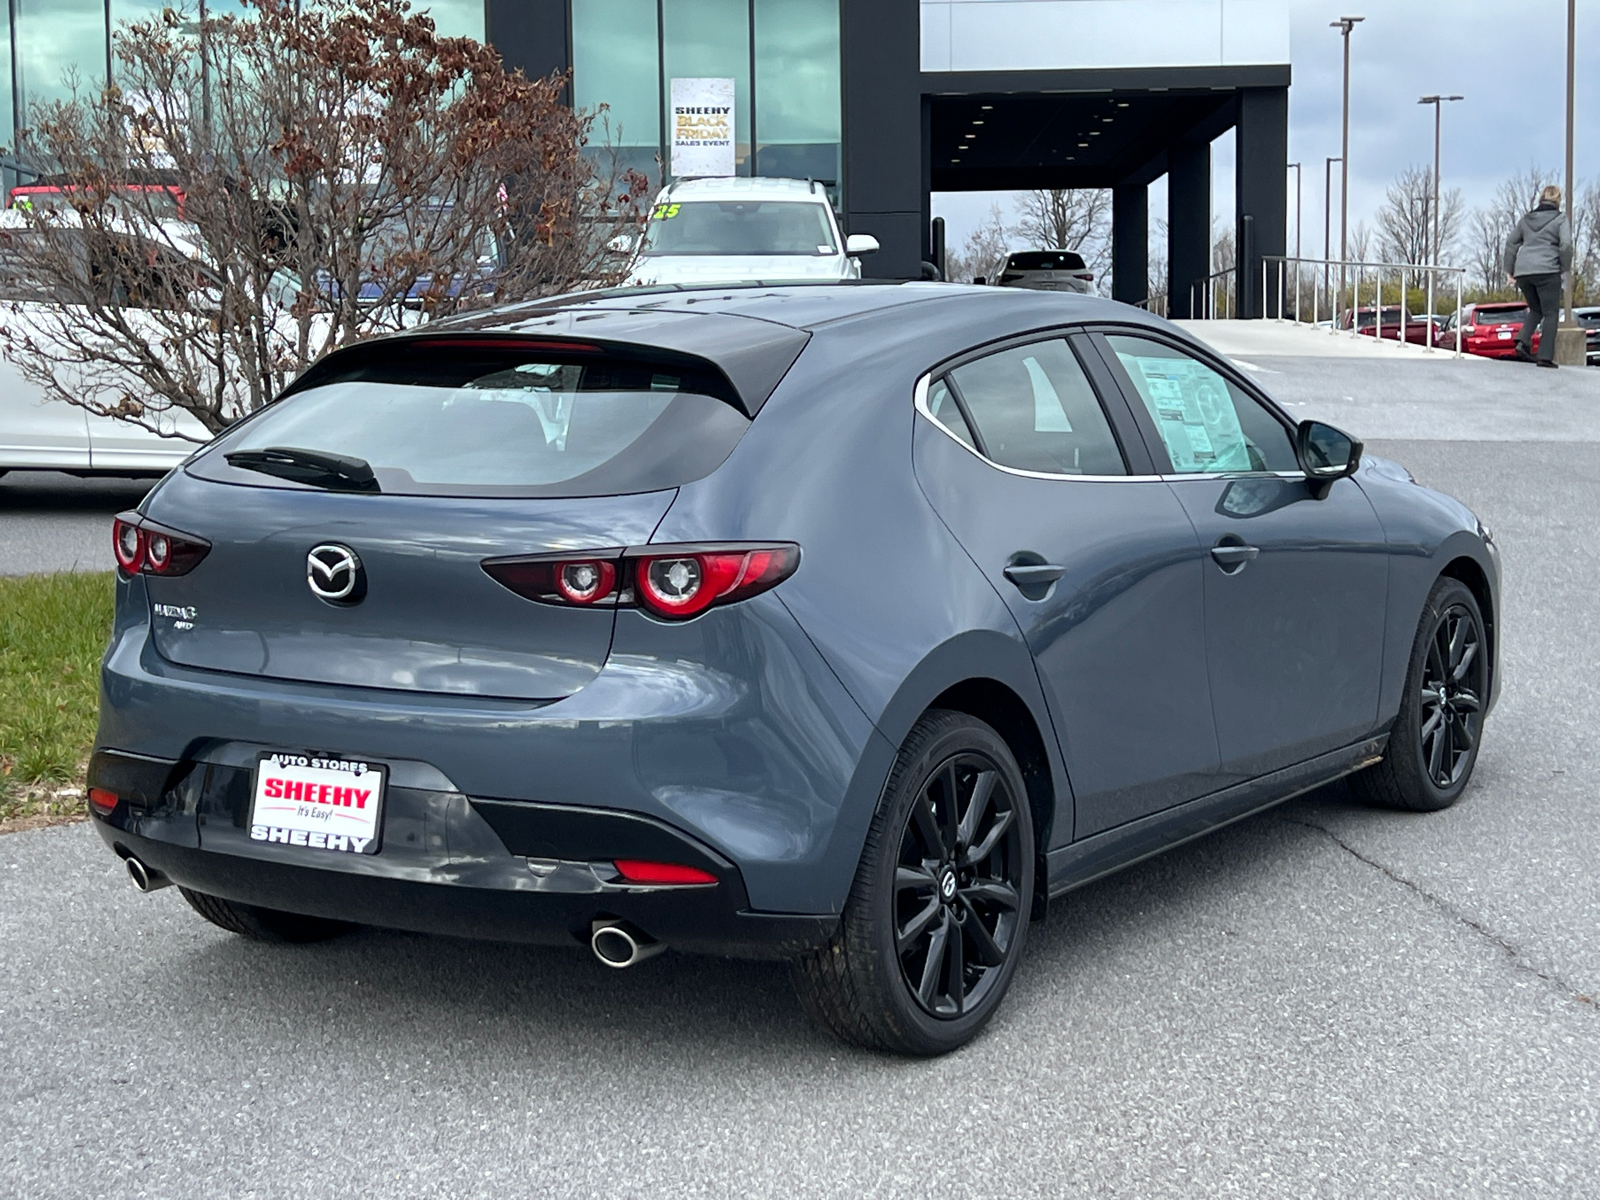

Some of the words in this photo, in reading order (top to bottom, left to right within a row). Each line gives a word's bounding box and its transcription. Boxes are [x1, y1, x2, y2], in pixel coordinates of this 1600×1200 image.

[675, 107, 730, 115] SHEEHY
[677, 115, 728, 127] BLACK
[676, 127, 731, 139] FRIDAY
[270, 754, 308, 767] AUTO
[311, 758, 368, 773] STORES
[264, 777, 372, 809] SHEEHY
[297, 805, 310, 817] It's
[250, 825, 371, 853] SHEEHY
